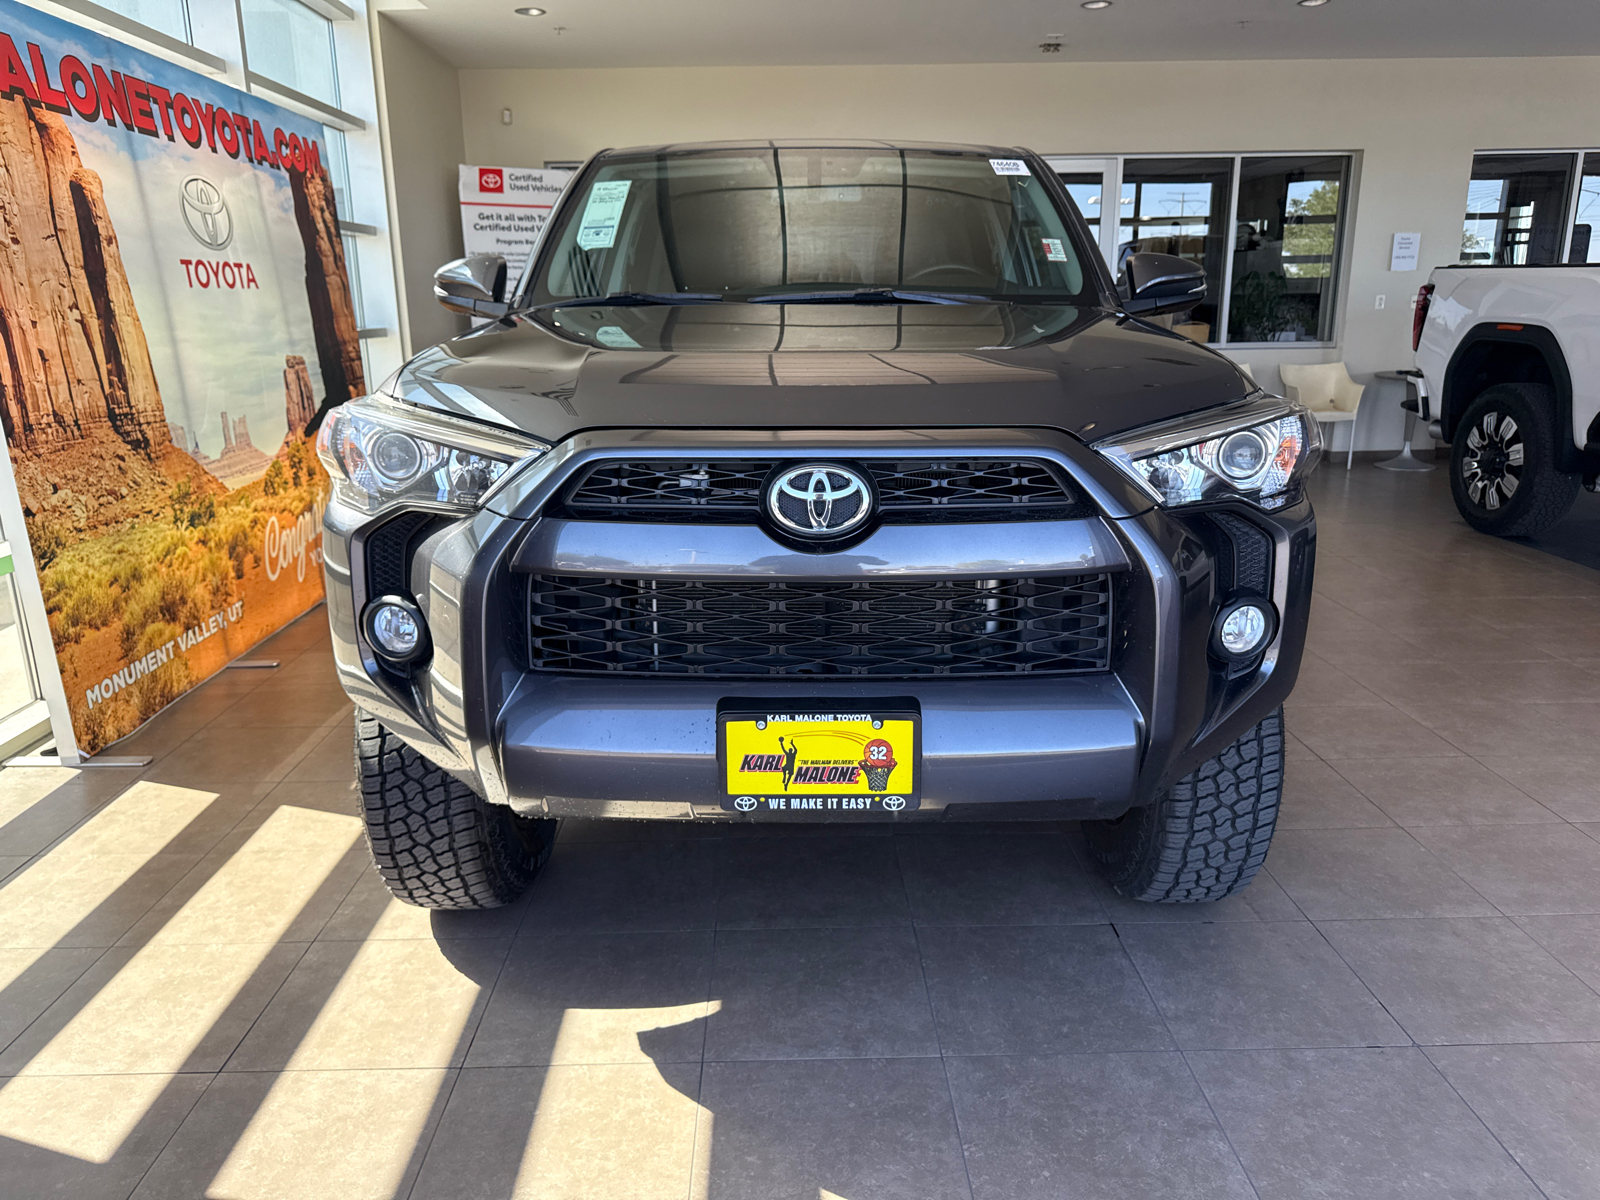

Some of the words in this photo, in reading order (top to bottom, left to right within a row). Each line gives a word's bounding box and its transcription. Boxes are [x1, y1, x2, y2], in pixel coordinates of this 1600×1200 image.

[508, 173, 543, 182] Certified
[478, 212, 494, 221] Get
[504, 213, 515, 221] all
[517, 213, 536, 222] with
[473, 223, 512, 231] Certified
[513, 223, 535, 232] Used
[496, 238, 524, 246] Program
[179, 259, 259, 289] TOYOTA
[86, 641, 175, 709] MONUMENT
[177, 613, 228, 652] VALLEY,
[227, 601, 243, 623] UT
[767, 714, 793, 722] KARL
[795, 714, 834, 722] MALONE
[836, 714, 872, 722] TOYOTA
[869, 745, 887, 760] 32
[739, 754, 785, 772] KARL
[792, 766, 861, 784] MALONE
[768, 798, 787, 809] WE
[790, 798, 823, 809] MAKE
[827, 798, 838, 809] IT
[842, 797, 871, 809] EASY
